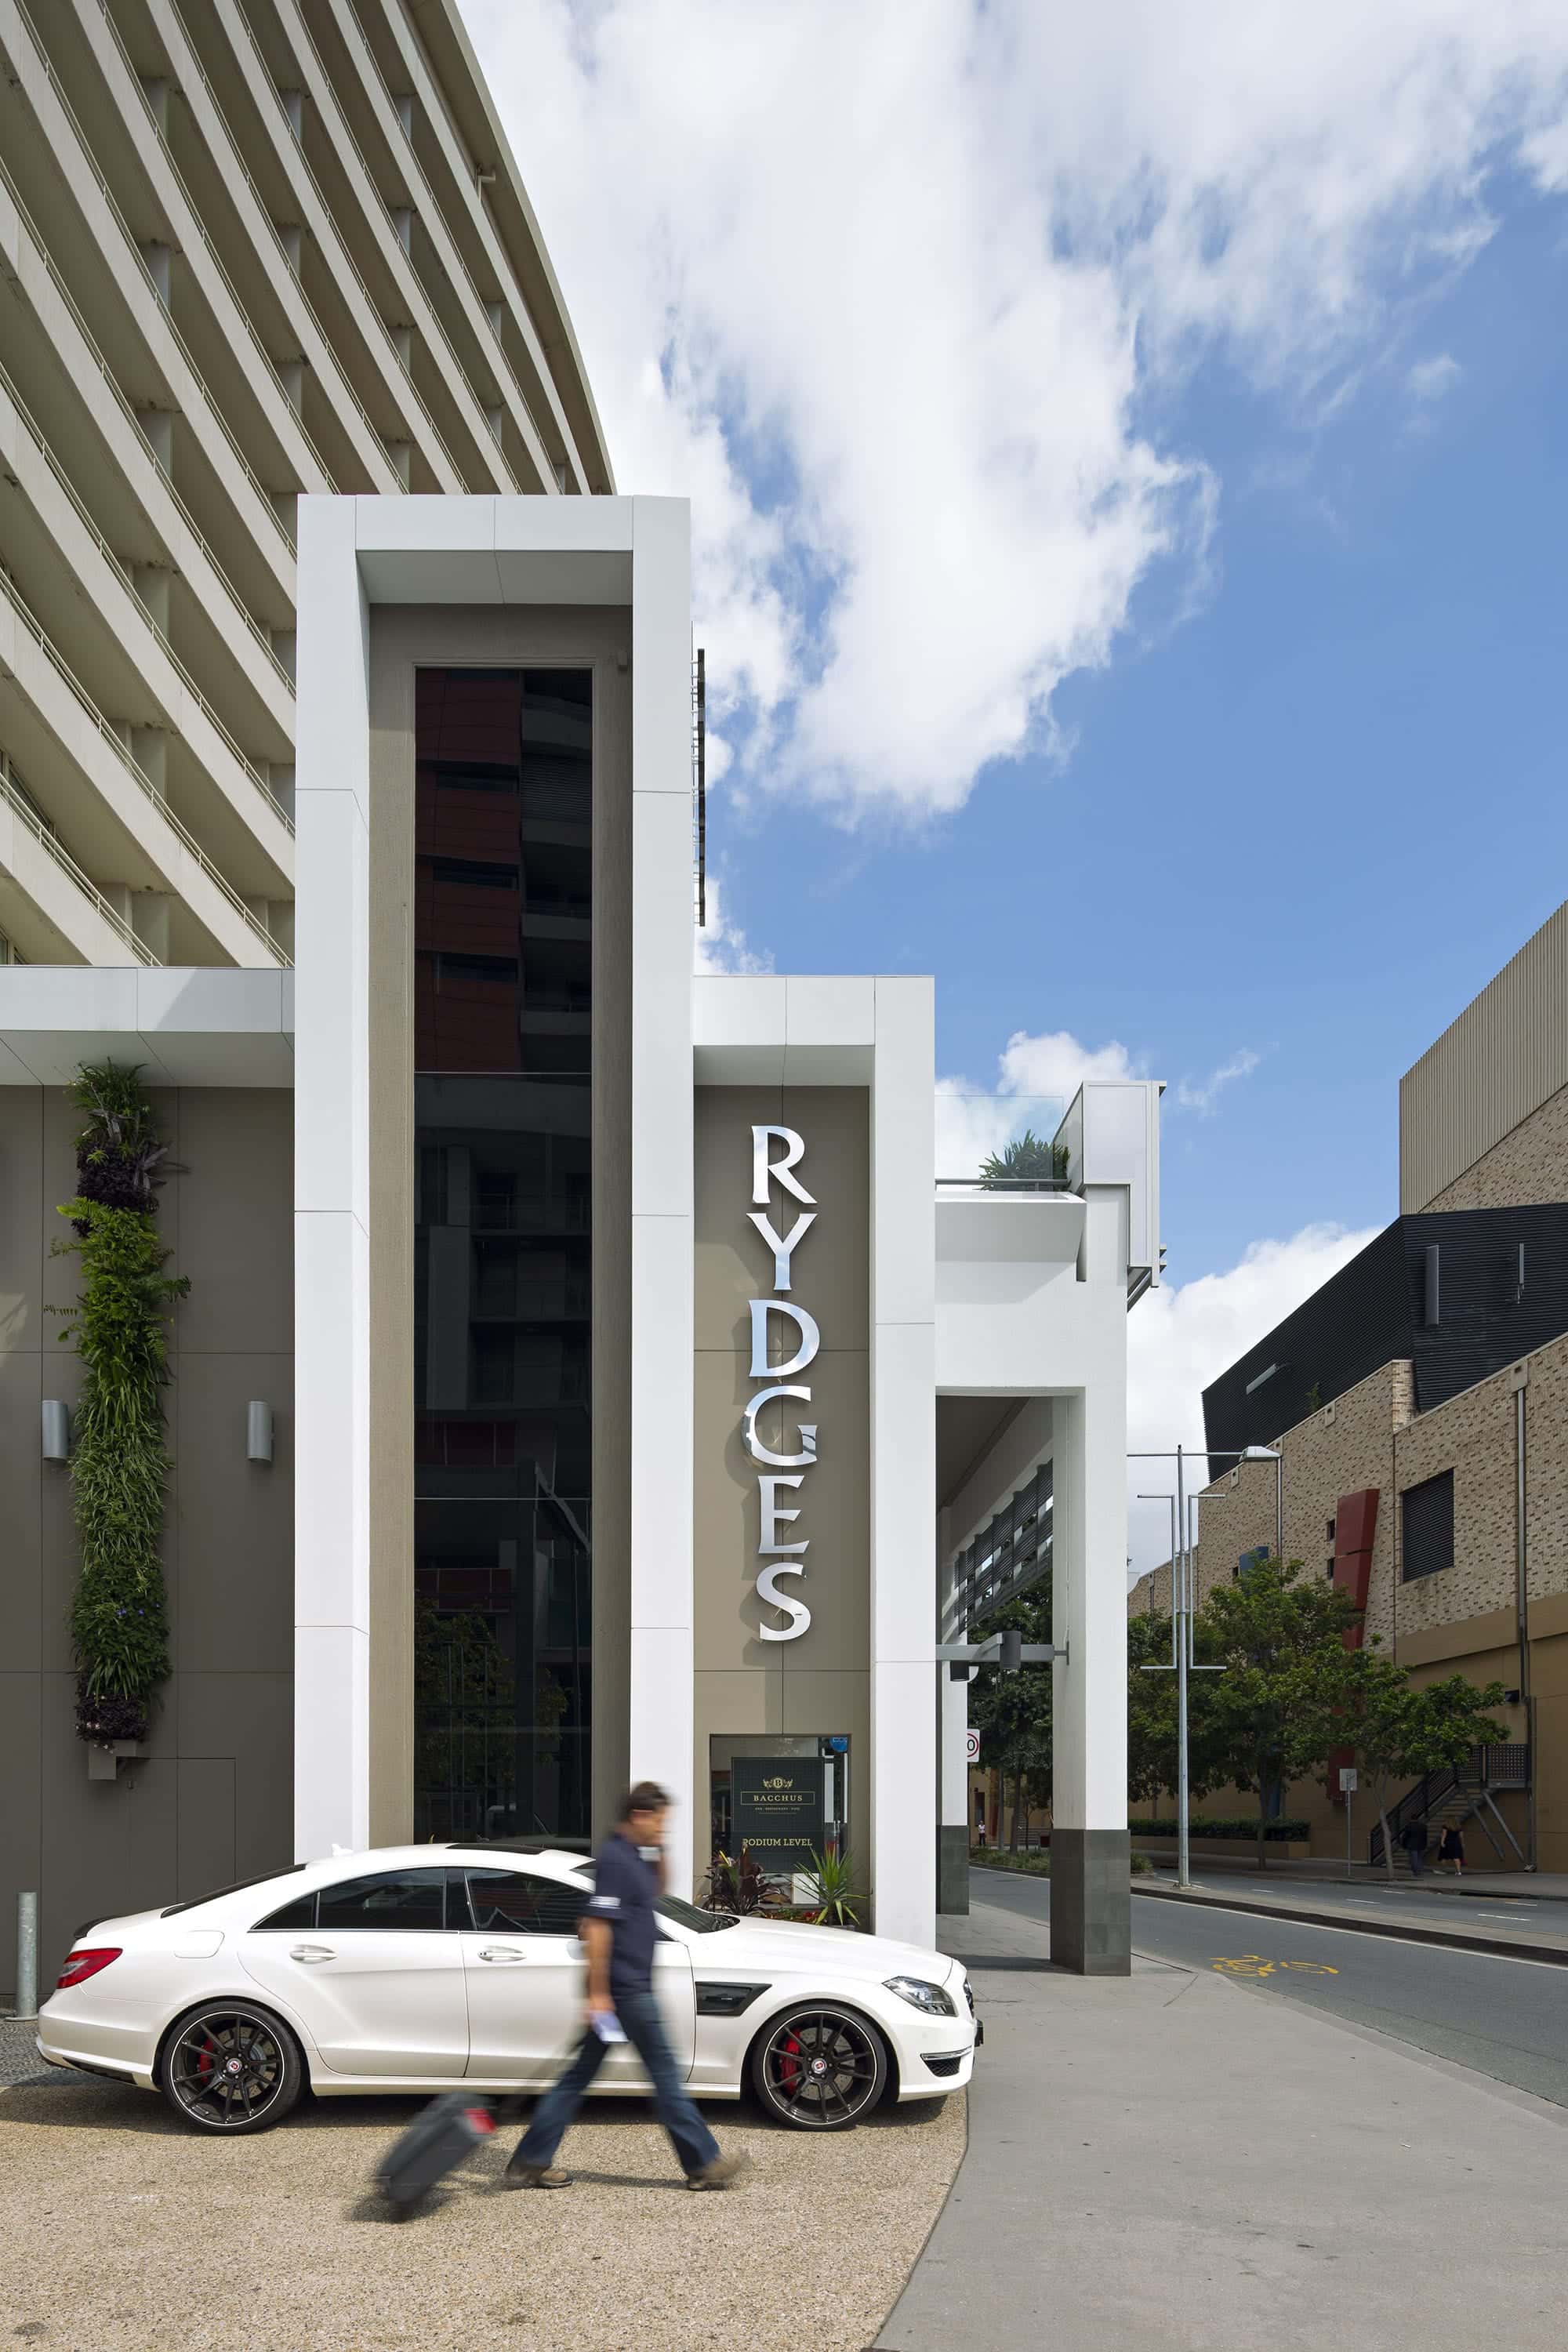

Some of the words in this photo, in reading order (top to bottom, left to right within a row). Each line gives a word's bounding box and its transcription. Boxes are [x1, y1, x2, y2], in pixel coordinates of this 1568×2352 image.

[742, 1125, 820, 1642] RYDGES
[967, 1739, 975, 1751] 0
[742, 1838, 782, 1846] PODIUM
[783, 1838, 812, 1846] LEVEL
